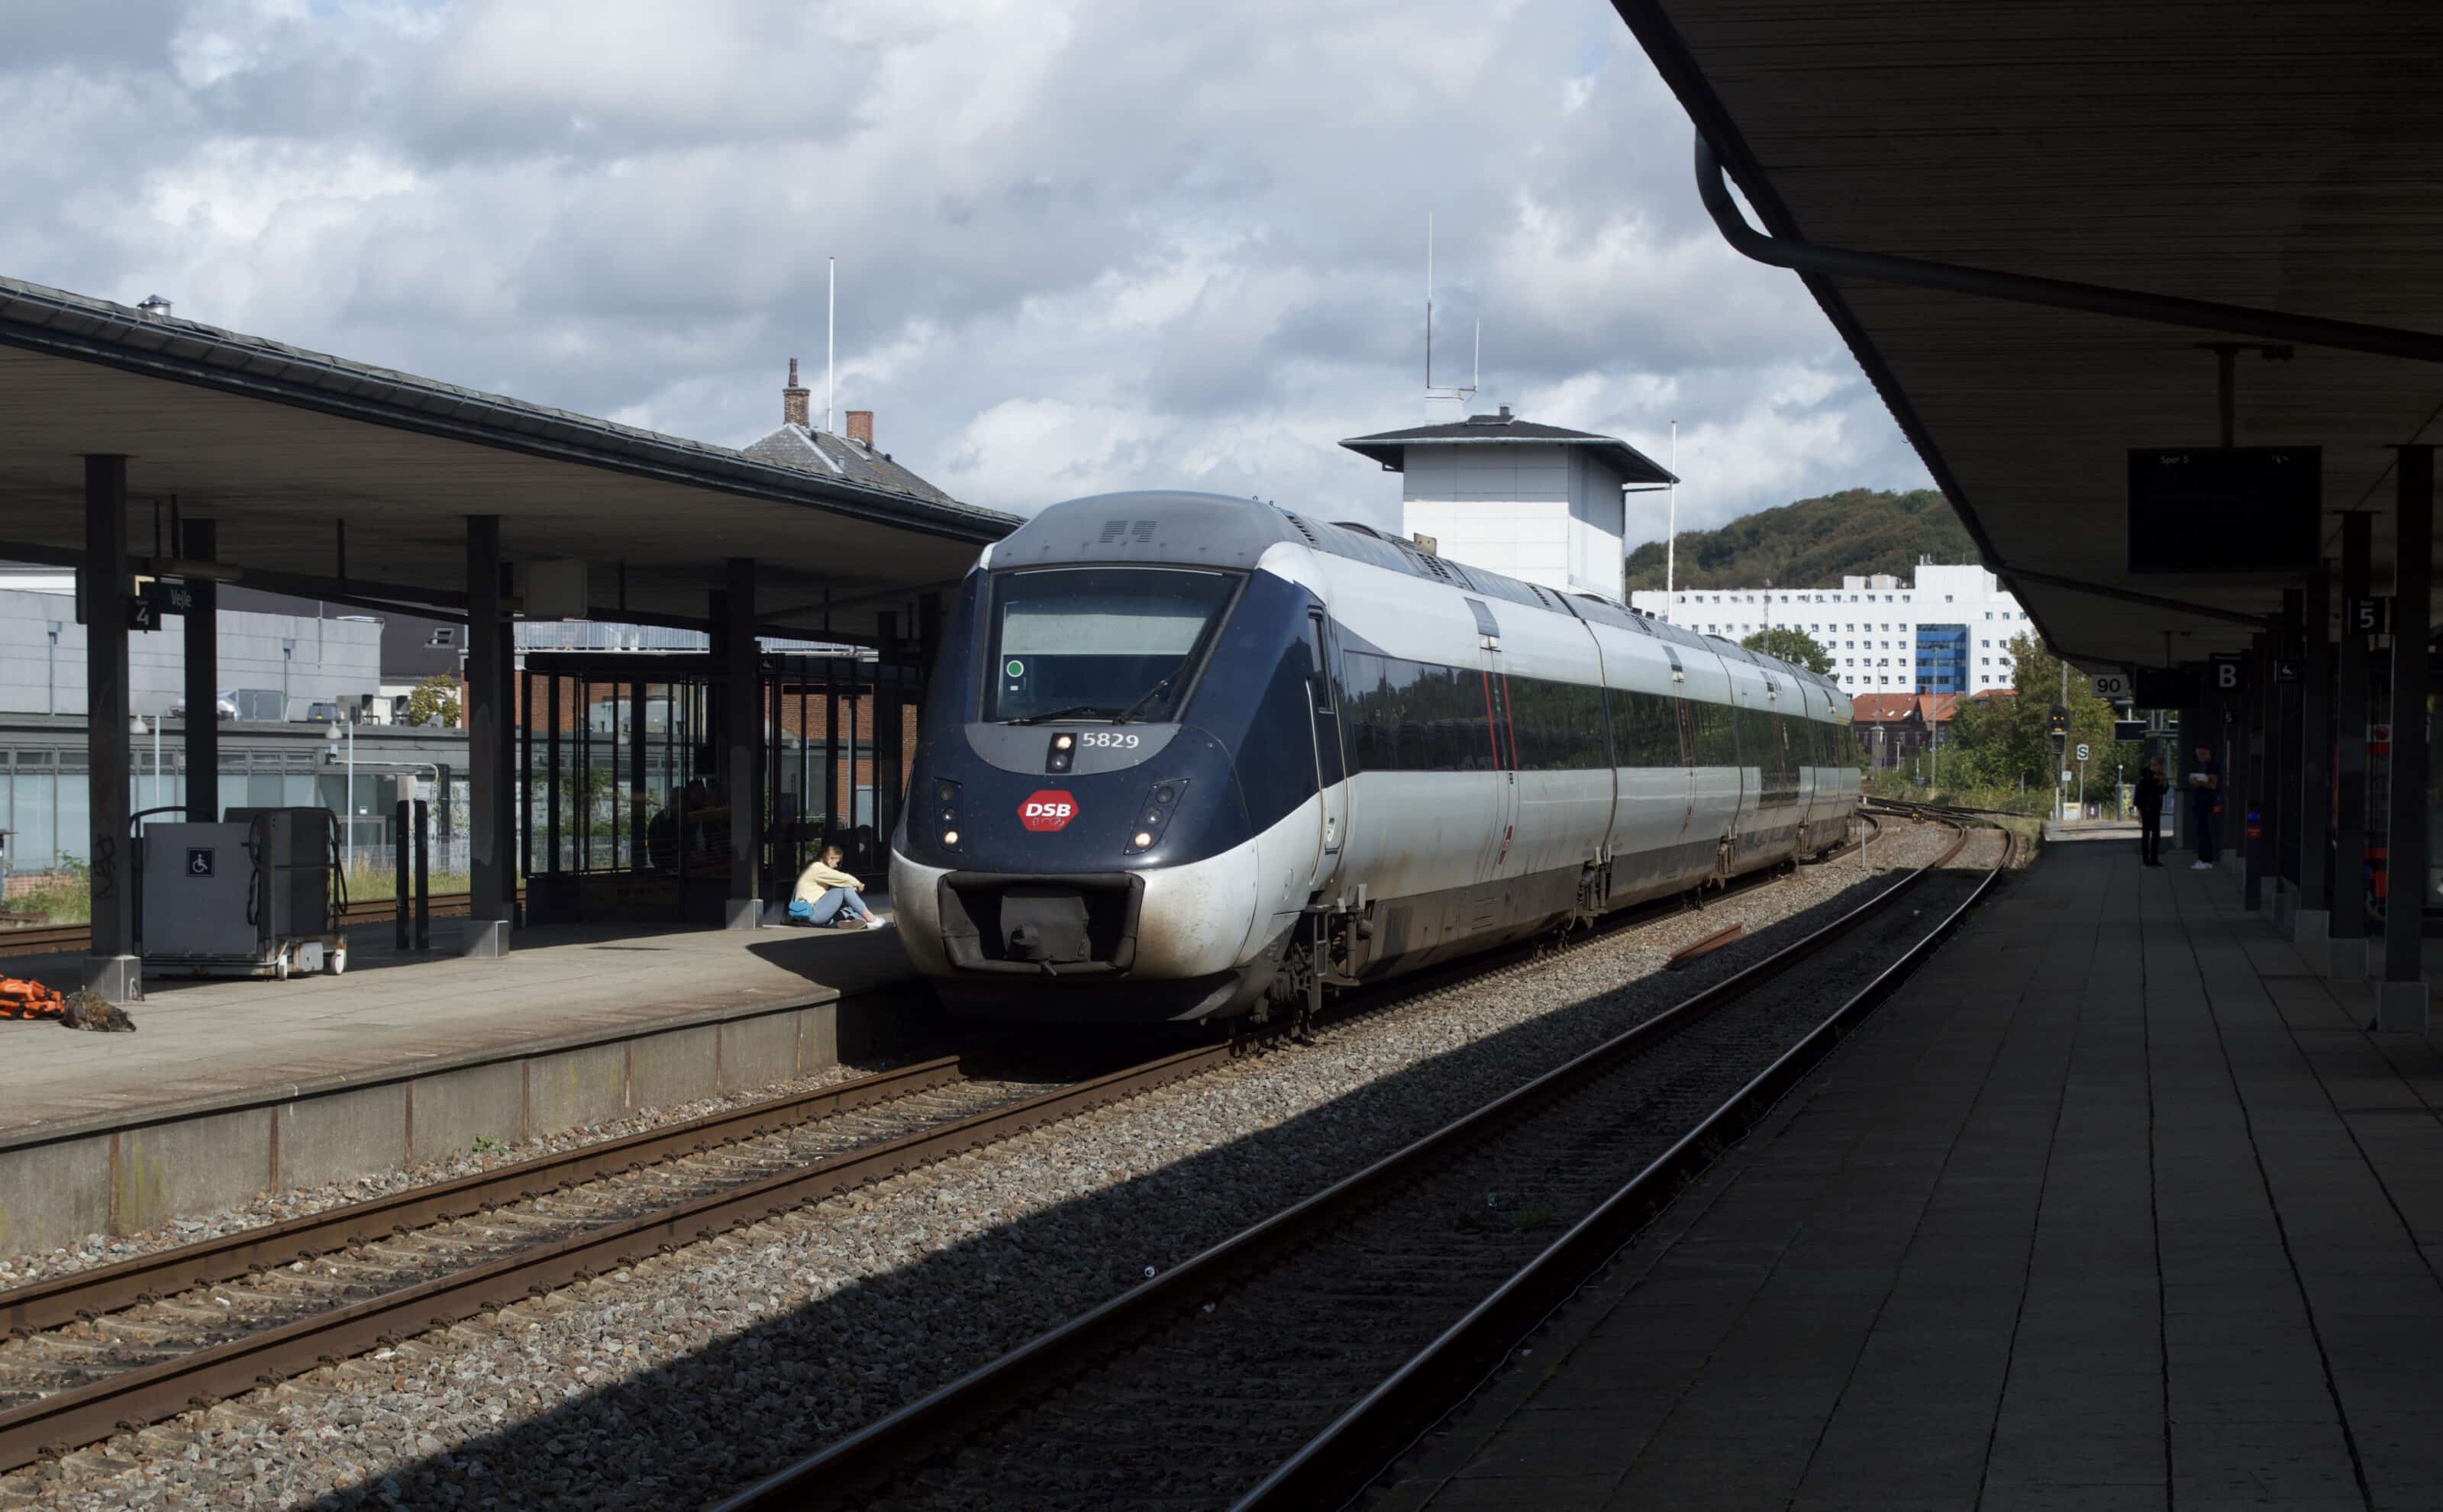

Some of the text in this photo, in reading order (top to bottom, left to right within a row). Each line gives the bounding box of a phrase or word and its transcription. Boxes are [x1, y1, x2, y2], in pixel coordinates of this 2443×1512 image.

[171, 588, 192, 610] Vejle
[136, 607, 150, 626] 4
[2359, 608, 2376, 629] 5
[2219, 664, 2237, 688] B
[2097, 679, 2122, 693] 90
[2225, 714, 2232, 724] 5
[1082, 732, 1139, 750] 5829
[2078, 746, 2087, 758] S
[1025, 803, 1071, 817] DSB
